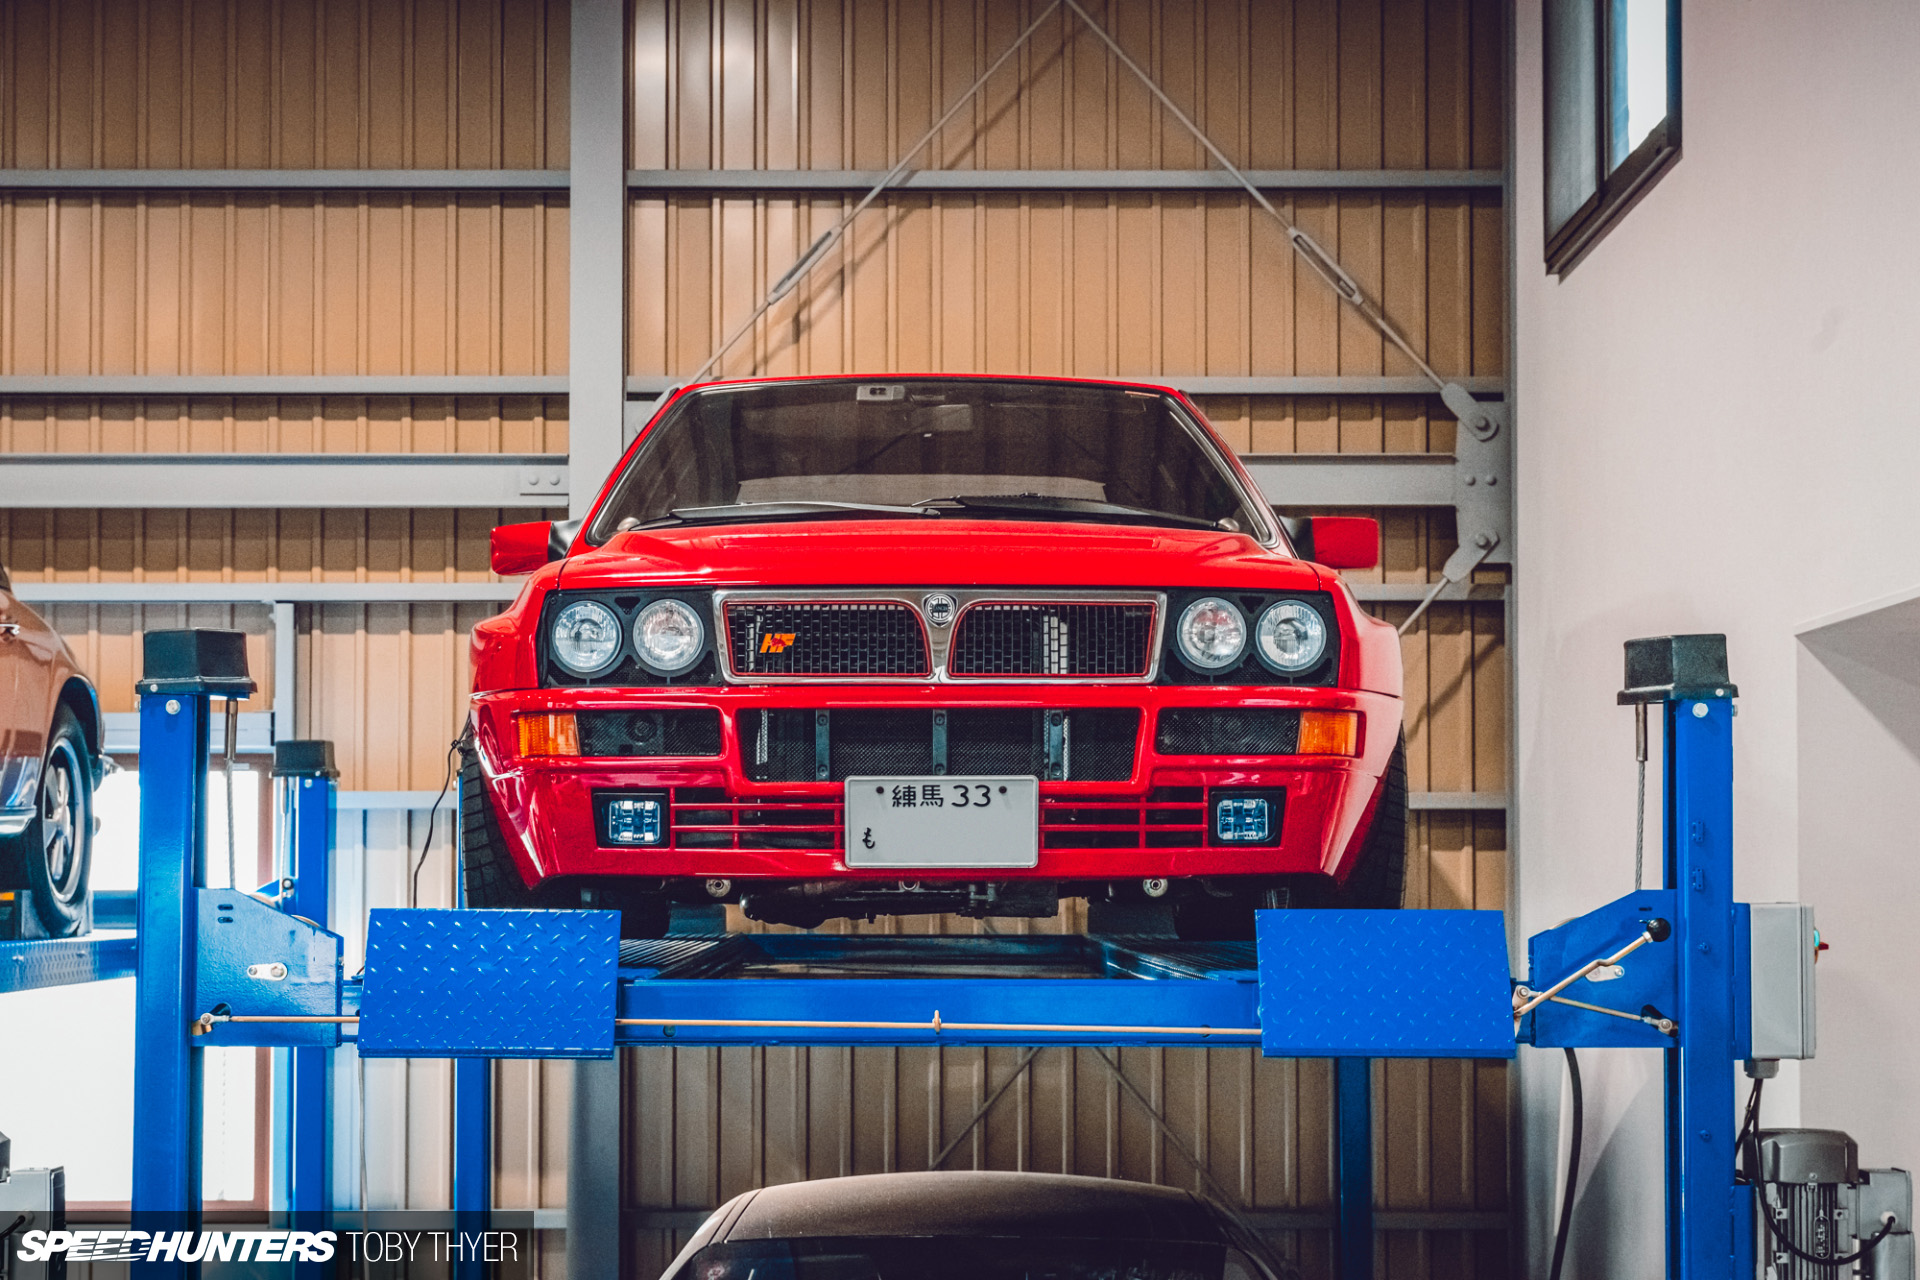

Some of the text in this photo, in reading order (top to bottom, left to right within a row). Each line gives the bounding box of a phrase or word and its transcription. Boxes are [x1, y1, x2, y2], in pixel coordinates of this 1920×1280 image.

[892, 784, 991, 808] 練馬 33
[862, 827, 876, 849] も
